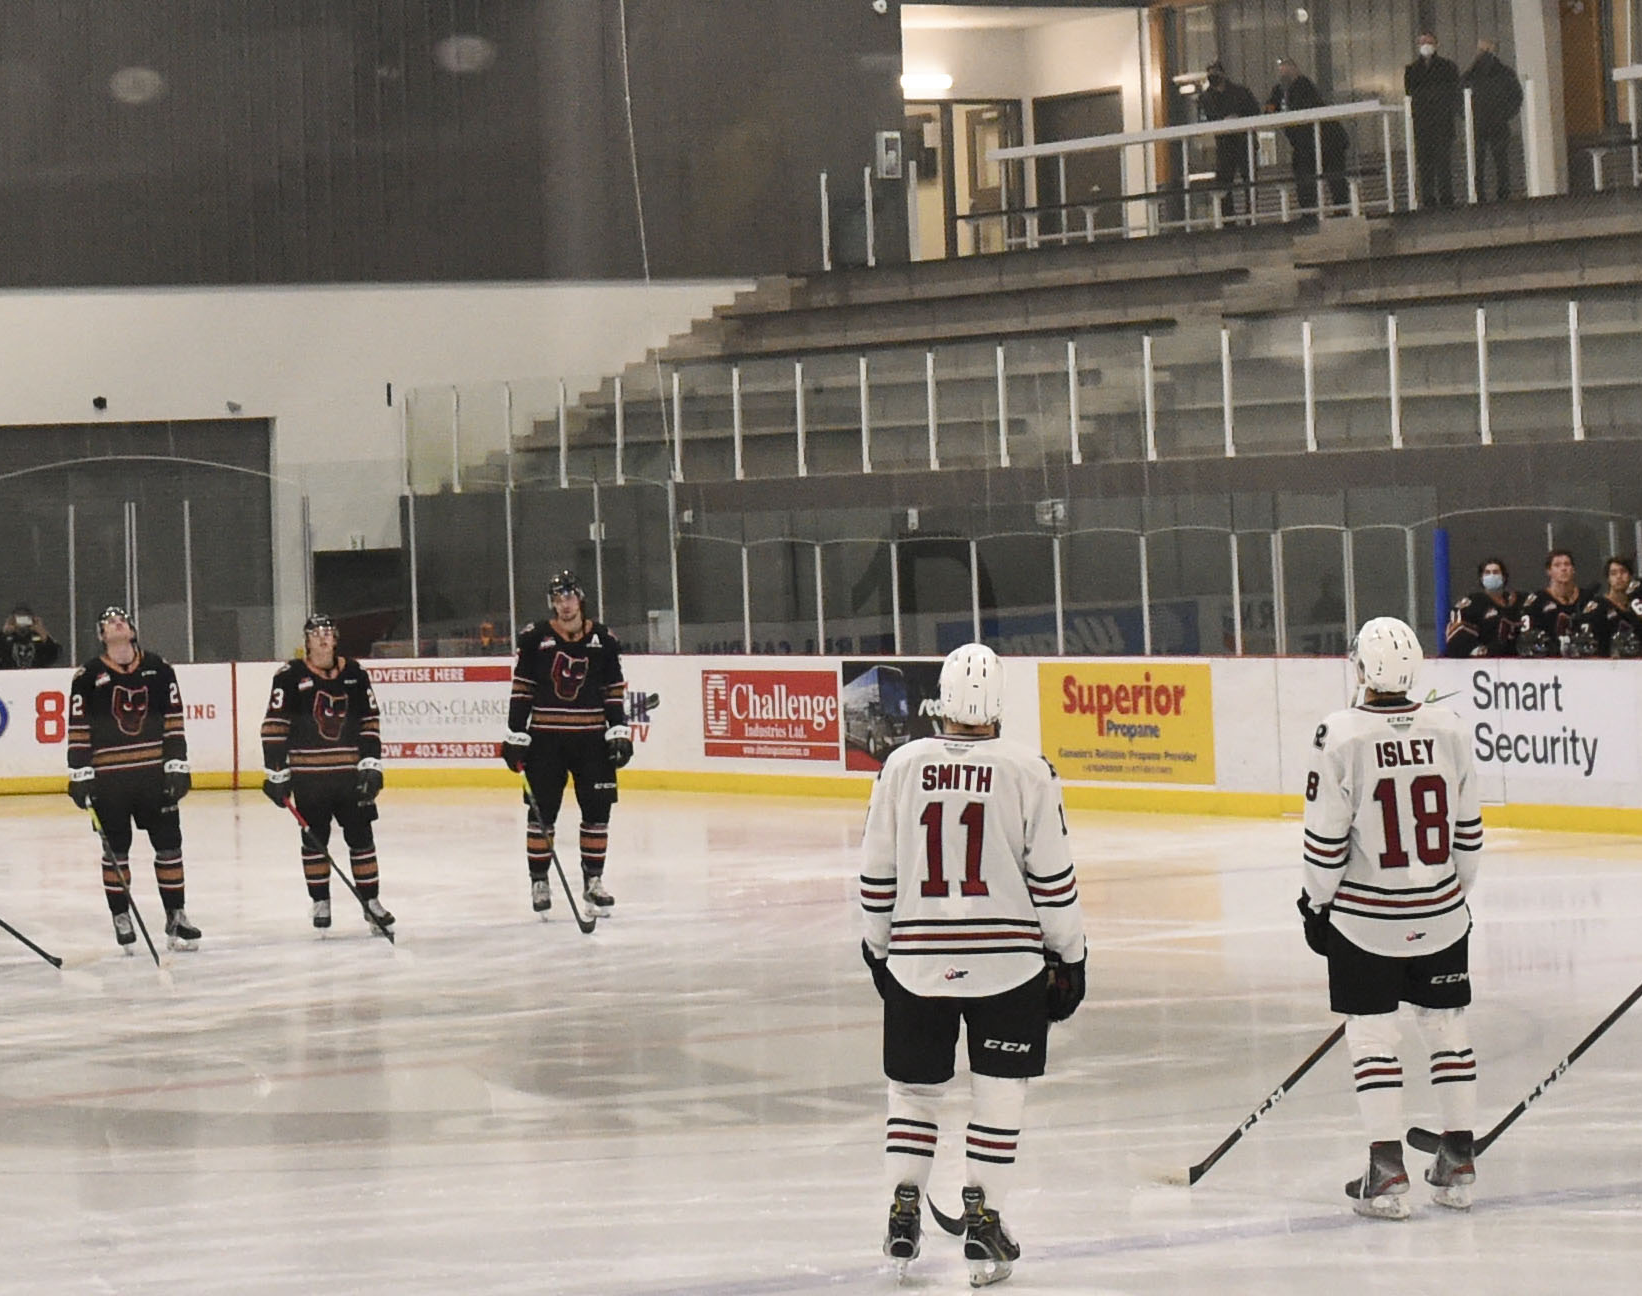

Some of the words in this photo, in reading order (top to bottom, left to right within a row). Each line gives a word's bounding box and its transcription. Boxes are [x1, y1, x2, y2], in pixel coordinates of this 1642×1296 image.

[369, 668, 431, 682] ADVERTISE
[434, 667, 465, 681] HERE
[72, 694, 83, 716] 2
[271, 687, 284, 709] 3
[1062, 671, 1186, 737] Superior
[1473, 670, 1563, 712] Smart
[730, 683, 837, 731] Challenge
[1107, 720, 1161, 742] Propane
[1375, 738, 1435, 769] ISLEY
[1475, 722, 1598, 776] Security
[922, 764, 993, 793] SMITH
[1305, 770, 1320, 802] 8
[1373, 774, 1450, 870] 18
[920, 802, 990, 898] 11
[984, 1038, 1031, 1054] CCM
